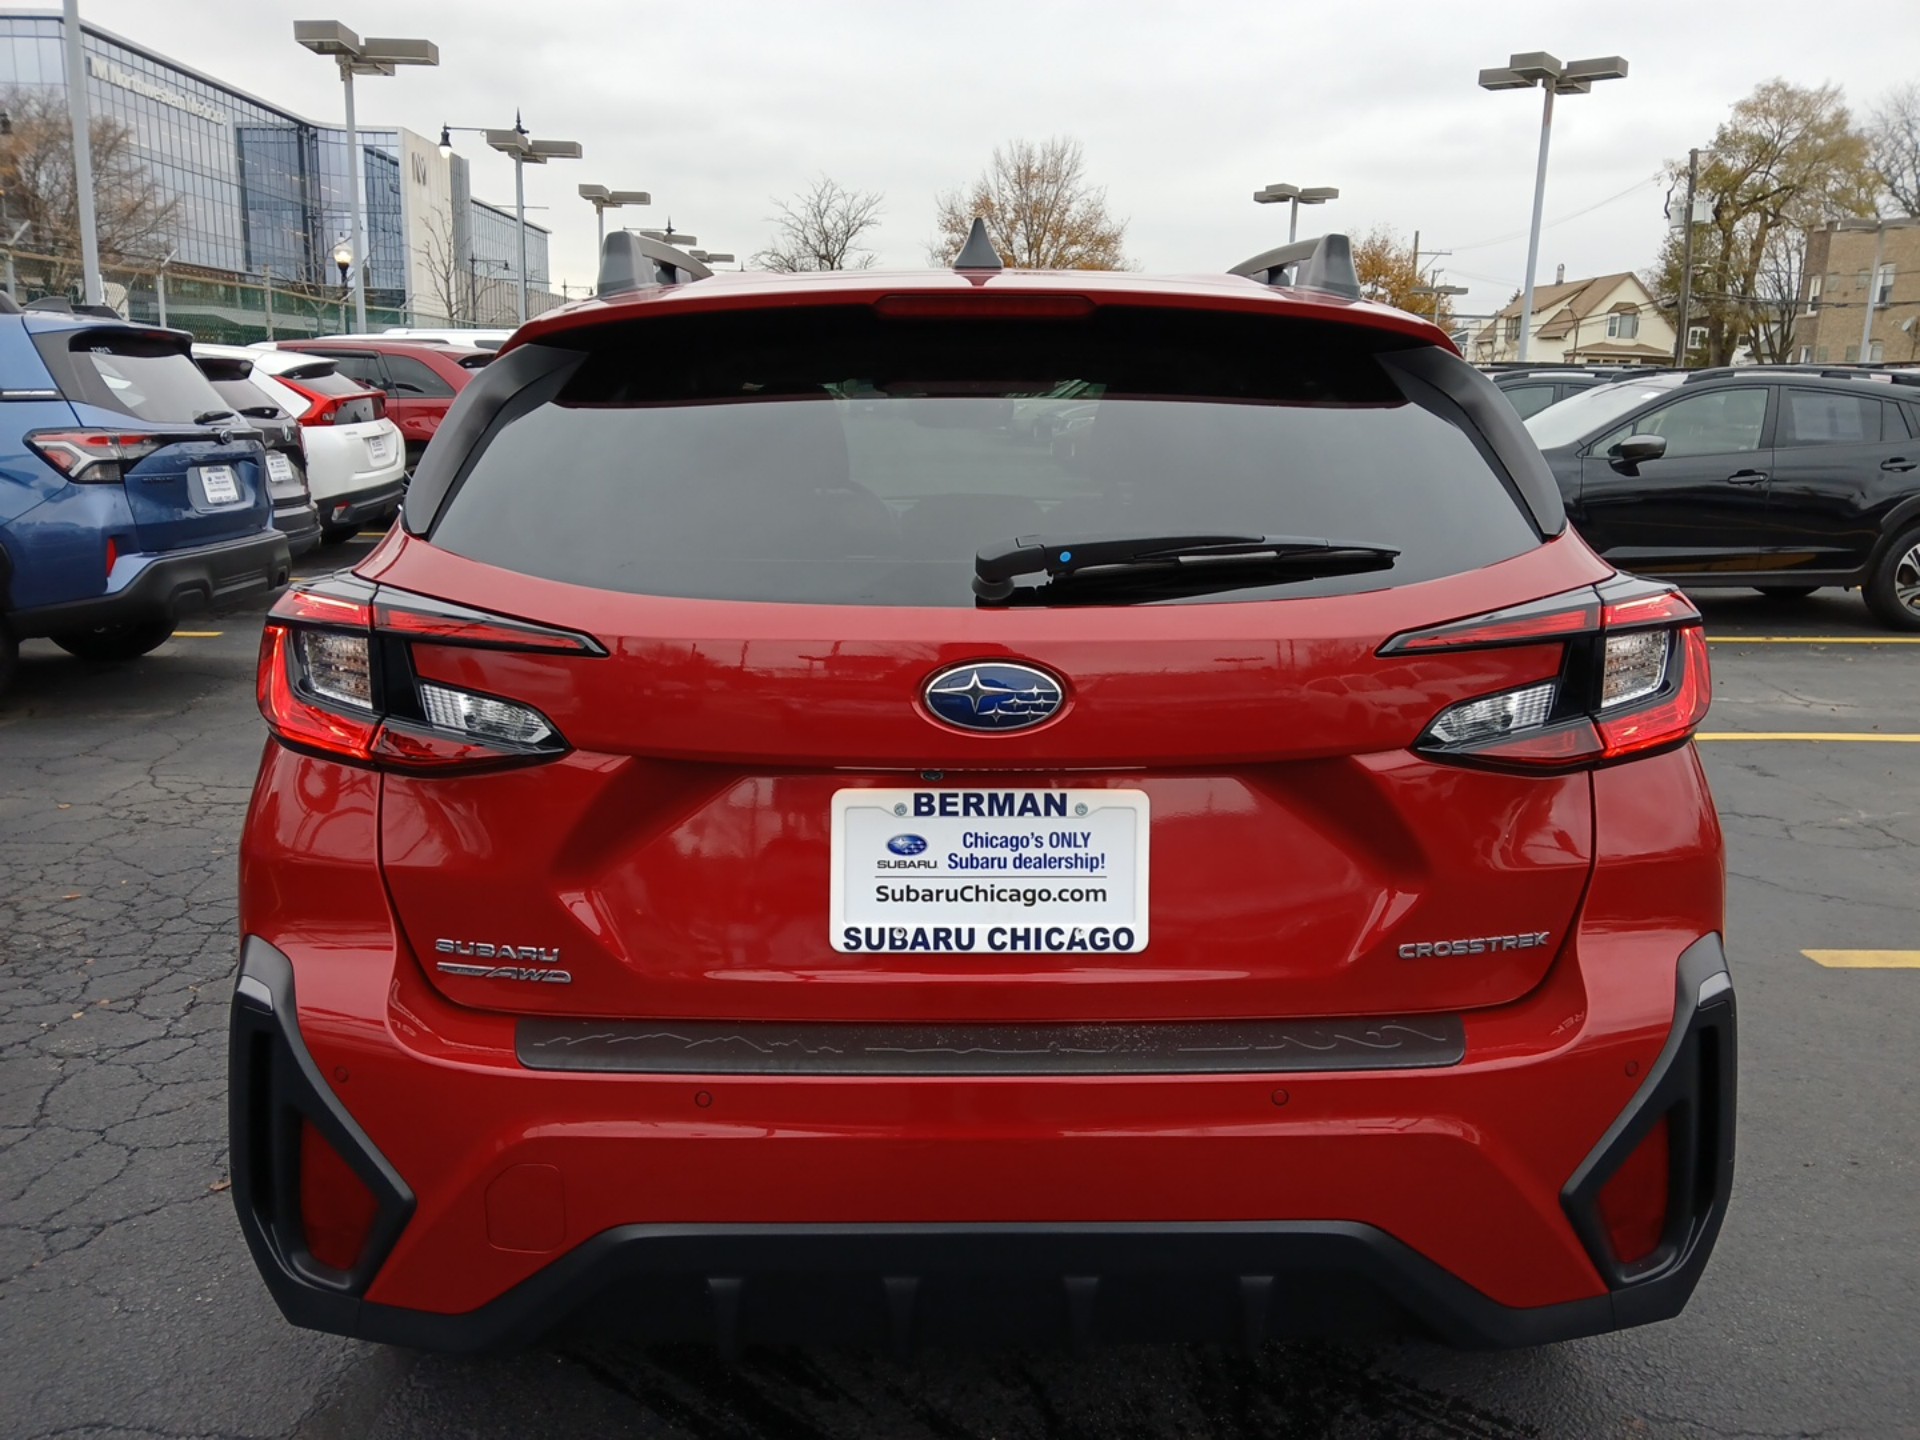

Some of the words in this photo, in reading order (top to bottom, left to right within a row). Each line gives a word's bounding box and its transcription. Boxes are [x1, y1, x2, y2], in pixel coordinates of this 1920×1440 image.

[109, 63, 186, 110] Northwestern
[187, 94, 227, 125] Medicine
[913, 792, 1068, 817] BERMAN
[1048, 831, 1092, 849] ONLY
[876, 859, 938, 869] SUBARU
[947, 853, 1008, 870] Subaru
[1012, 853, 1106, 872] dealership!
[875, 884, 1108, 907] SubaruChicago.com
[435, 938, 560, 962] SUBARU
[843, 927, 976, 951] SUBARU
[987, 927, 1135, 951] CHICAGO
[1398, 931, 1550, 959] CROSSTREK
[485, 966, 572, 983] AWD
